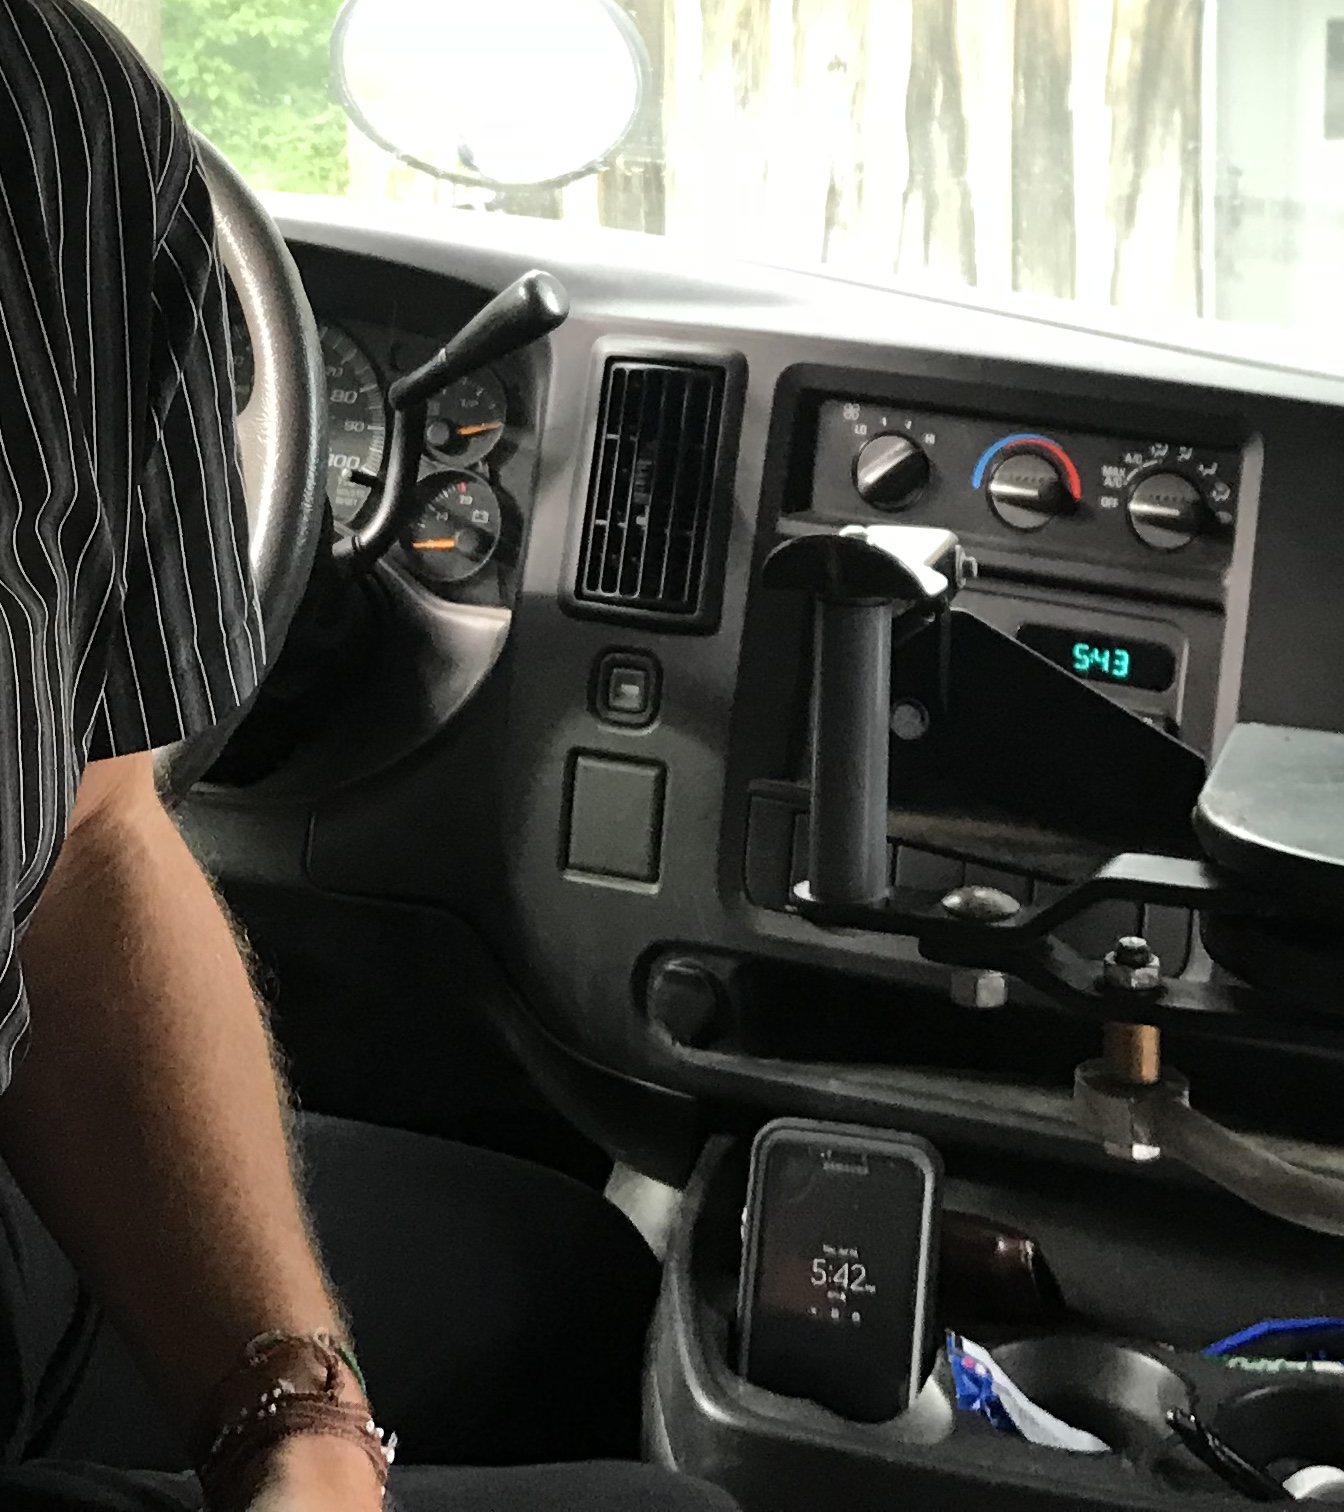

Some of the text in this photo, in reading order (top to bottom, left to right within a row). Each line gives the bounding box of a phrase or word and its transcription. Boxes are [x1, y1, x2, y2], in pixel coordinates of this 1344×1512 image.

[329, 389, 358, 404] 80
[854, 424, 868, 435] LO
[328, 452, 361, 469] 100
[1073, 642, 1130, 678] 5:43
[811, 1258, 866, 1292] 5:42
